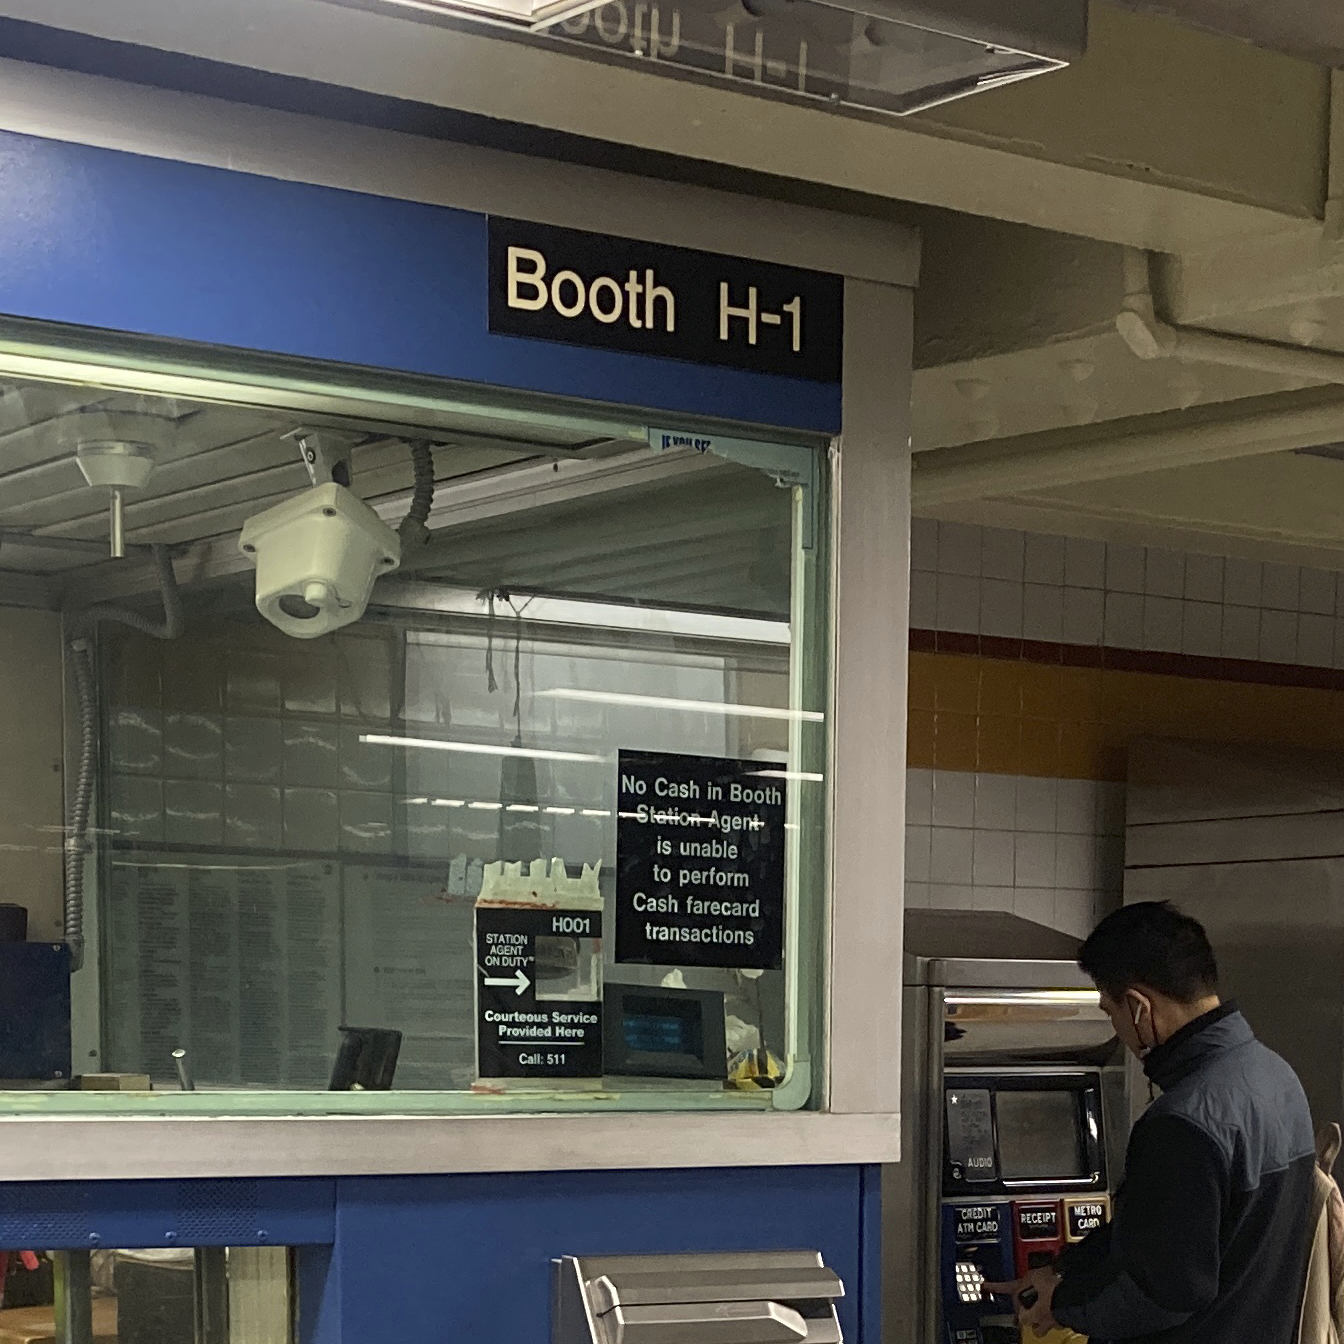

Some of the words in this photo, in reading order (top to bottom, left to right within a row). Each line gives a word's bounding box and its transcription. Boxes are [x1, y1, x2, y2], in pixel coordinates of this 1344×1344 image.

[507, 246, 675, 332] Booth
[719, 281, 801, 352] H-1
[621, 774, 647, 795] No
[654, 777, 700, 800] Cash
[707, 781, 722, 800] in
[730, 783, 782, 806] Booth
[636, 803, 701, 827] Station
[708, 809, 760, 833] Agent
[657, 835, 672, 855] is
[679, 839, 738, 859] unable
[653, 864, 671, 882] to
[679, 866, 749, 887] perform
[633, 892, 678, 913] Cash
[686, 895, 760, 917] farecard
[552, 916, 590, 934] H001
[486, 933, 528, 945] STATION
[645, 922, 754, 945] transactions
[489, 945, 523, 956] AGENT
[484, 956, 500, 966] ON
[484, 1010, 548, 1022] Courteous
[552, 1011, 598, 1023] Service
[498, 1025, 551, 1037] Provided
[555, 1026, 584, 1037] Here
[519, 1053, 544, 1065] Call:
[547, 1053, 565, 1065] 511
[968, 1157, 993, 1168] AUDIO
[961, 1207, 992, 1220] CREDIT
[1074, 1205, 1102, 1216] METRO
[1021, 1212, 1056, 1223] RECEIPT
[957, 1222, 974, 1233] ATM
[976, 1221, 998, 1232] CARD
